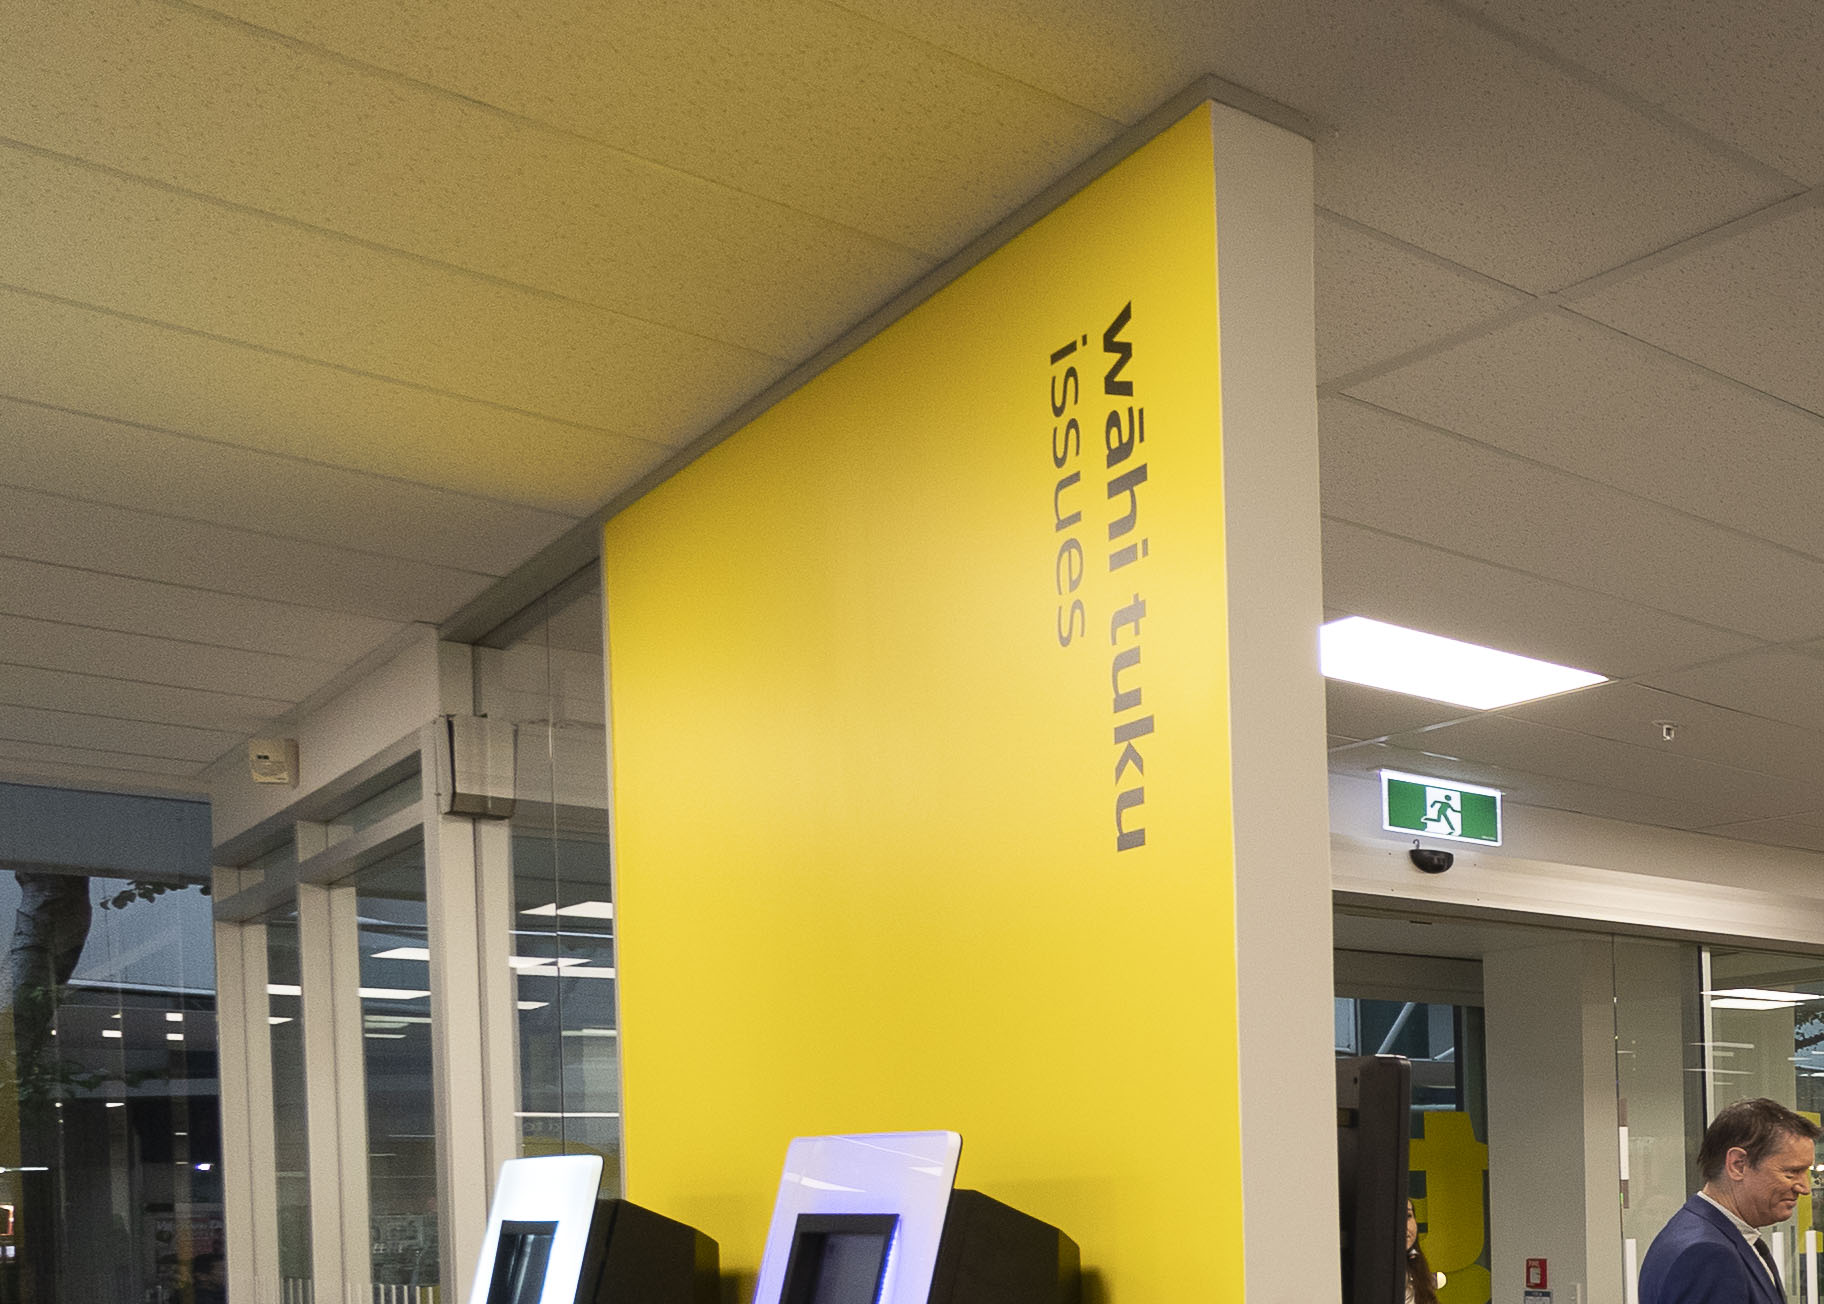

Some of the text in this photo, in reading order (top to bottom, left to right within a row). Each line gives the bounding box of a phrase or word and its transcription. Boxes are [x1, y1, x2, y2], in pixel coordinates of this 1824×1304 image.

[1050, 335, 1088, 648] issues
[1103, 300, 1155, 852] wāhi tuku
